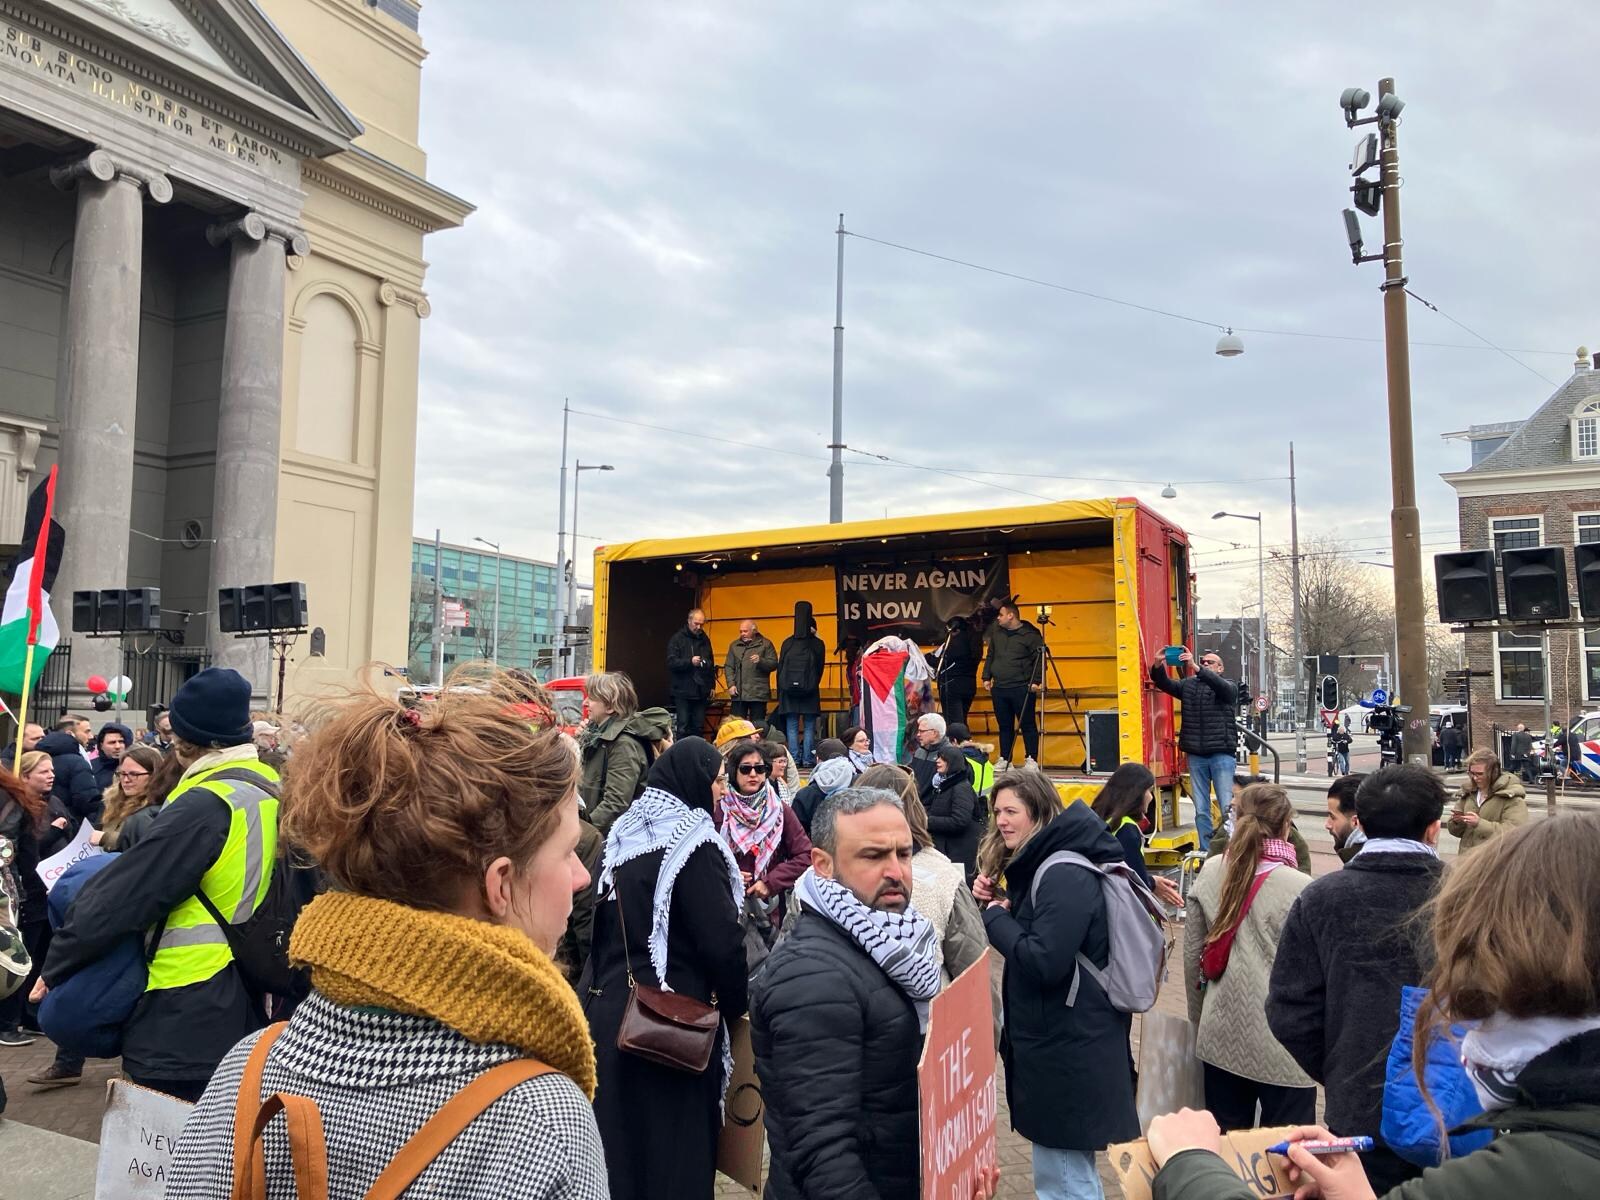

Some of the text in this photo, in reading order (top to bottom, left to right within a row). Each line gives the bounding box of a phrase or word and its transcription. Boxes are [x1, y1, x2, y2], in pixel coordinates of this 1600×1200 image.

[6, 27, 41, 52] SUB
[58, 50, 113, 84] SIGNO
[201, 116, 223, 134] ET
[231, 131, 282, 164] AARON,
[92, 80, 193, 136] ILLUSTRIOR
[208, 135, 259, 166] AEDES.
[842, 569, 986, 592] NEVER AGAIN
[844, 601, 922, 620] IS NOW
[939, 1027, 974, 1104] THE
